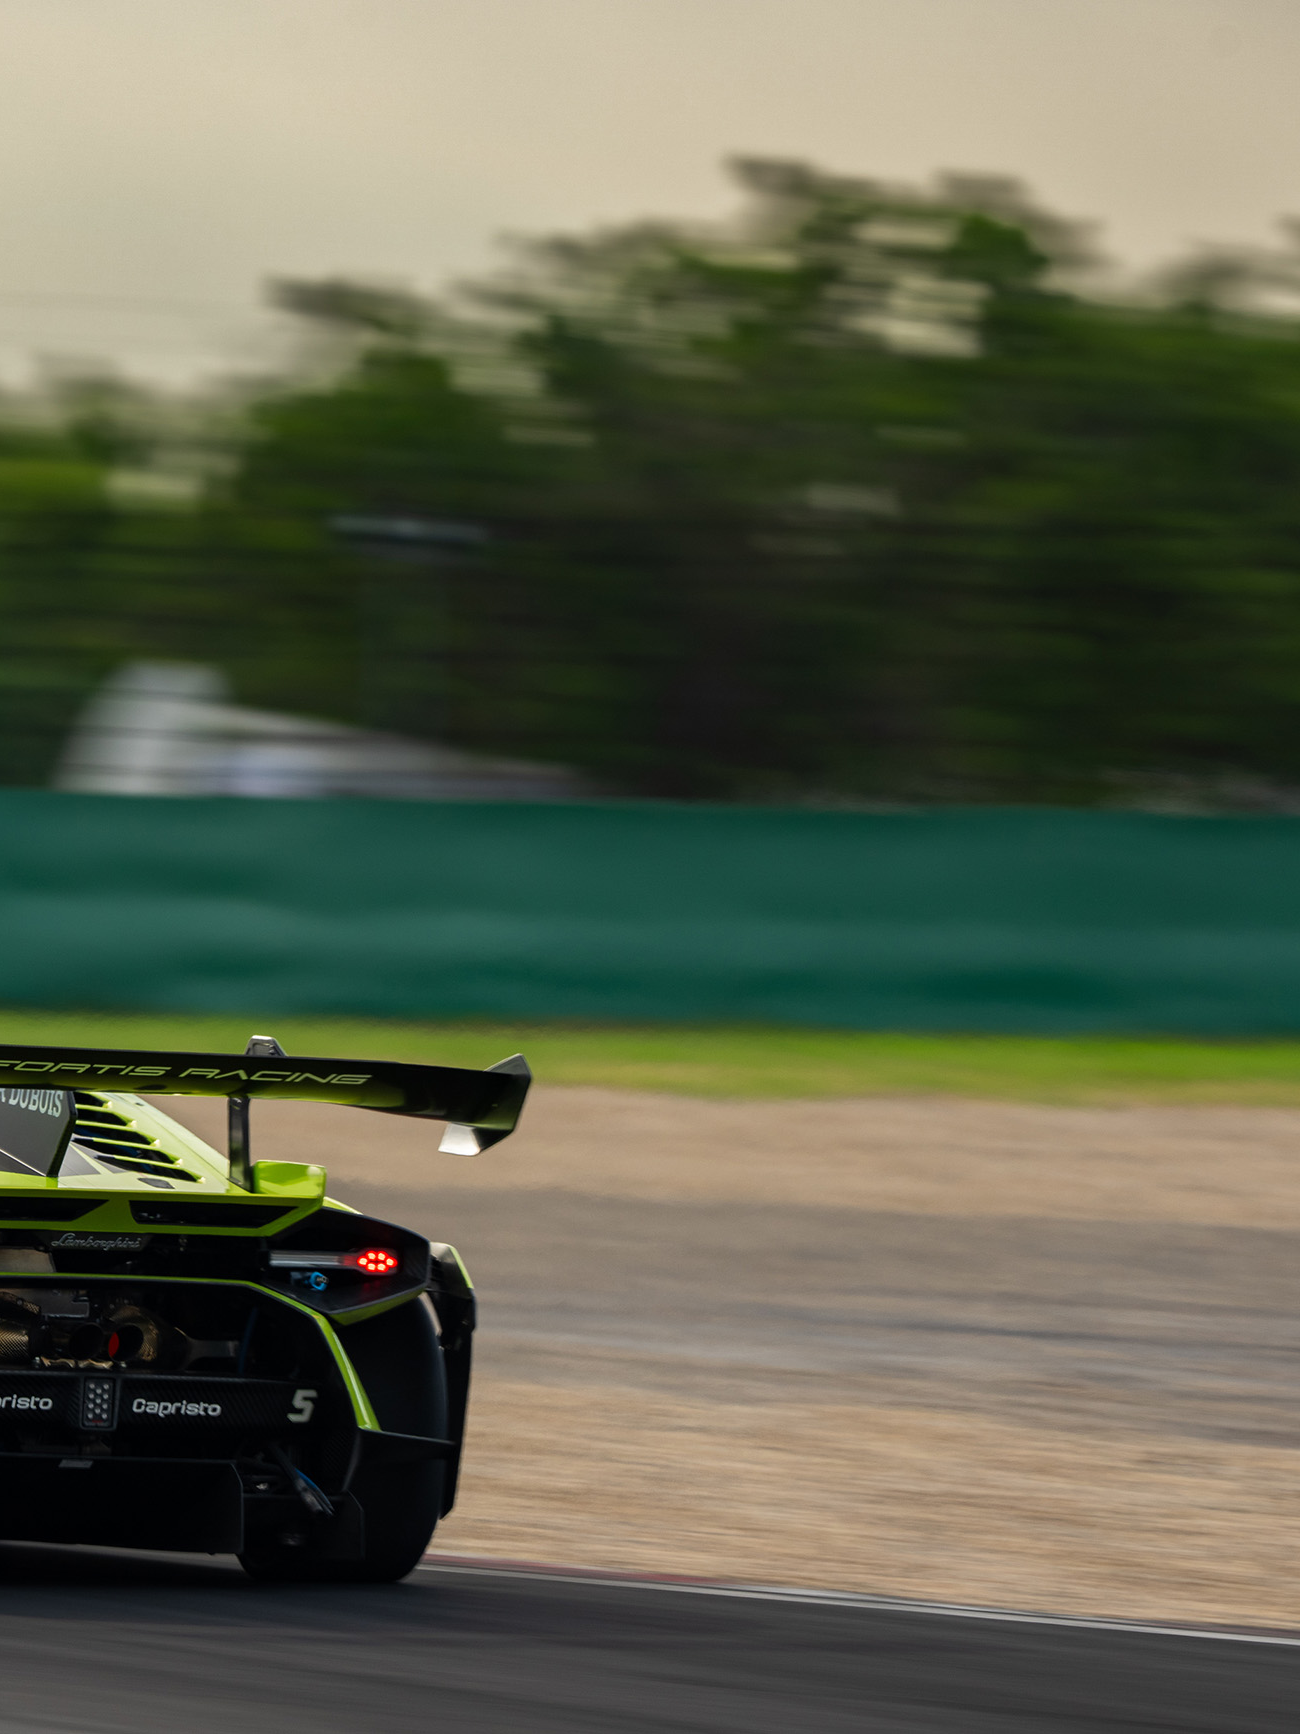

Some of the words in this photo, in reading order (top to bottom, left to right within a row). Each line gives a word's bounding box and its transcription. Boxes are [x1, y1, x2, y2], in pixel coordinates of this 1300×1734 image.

[179, 1067, 372, 1085] RACING
[8, 1088, 64, 1118] DUBUIS
[51, 1232, 142, 1251] Lamborghini
[132, 1398, 222, 1418] Capristo
[287, 1389, 318, 1424] 5
